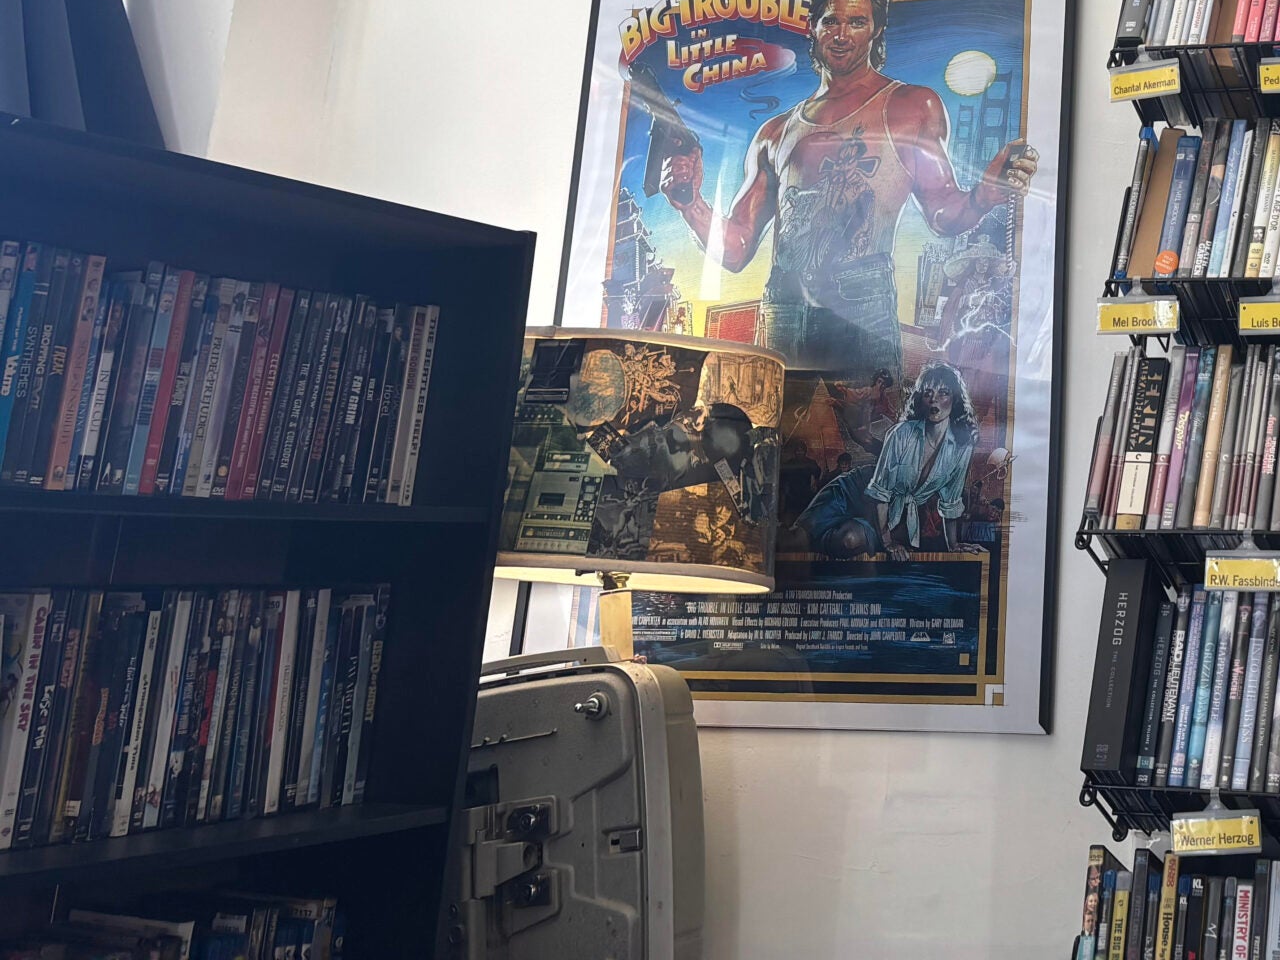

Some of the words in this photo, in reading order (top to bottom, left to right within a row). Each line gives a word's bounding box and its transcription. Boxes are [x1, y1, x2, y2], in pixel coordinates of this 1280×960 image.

[690, 28, 708, 39] IN
[667, 34, 739, 69] LITTLE
[683, 52, 768, 92] CHINA
[1114, 79, 1142, 96] Chantal
[1143, 77, 1176, 92] Akerman
[1112, 317, 1128, 328] Mel
[1131, 316, 1165, 328] Brook
[1250, 316, 1270, 328] Luis
[1210, 574, 1230, 586] R.W.
[1111, 592, 1128, 646] HERZOG
[1180, 834, 1216, 846] Werner
[1218, 833, 1254, 847] Herzog
